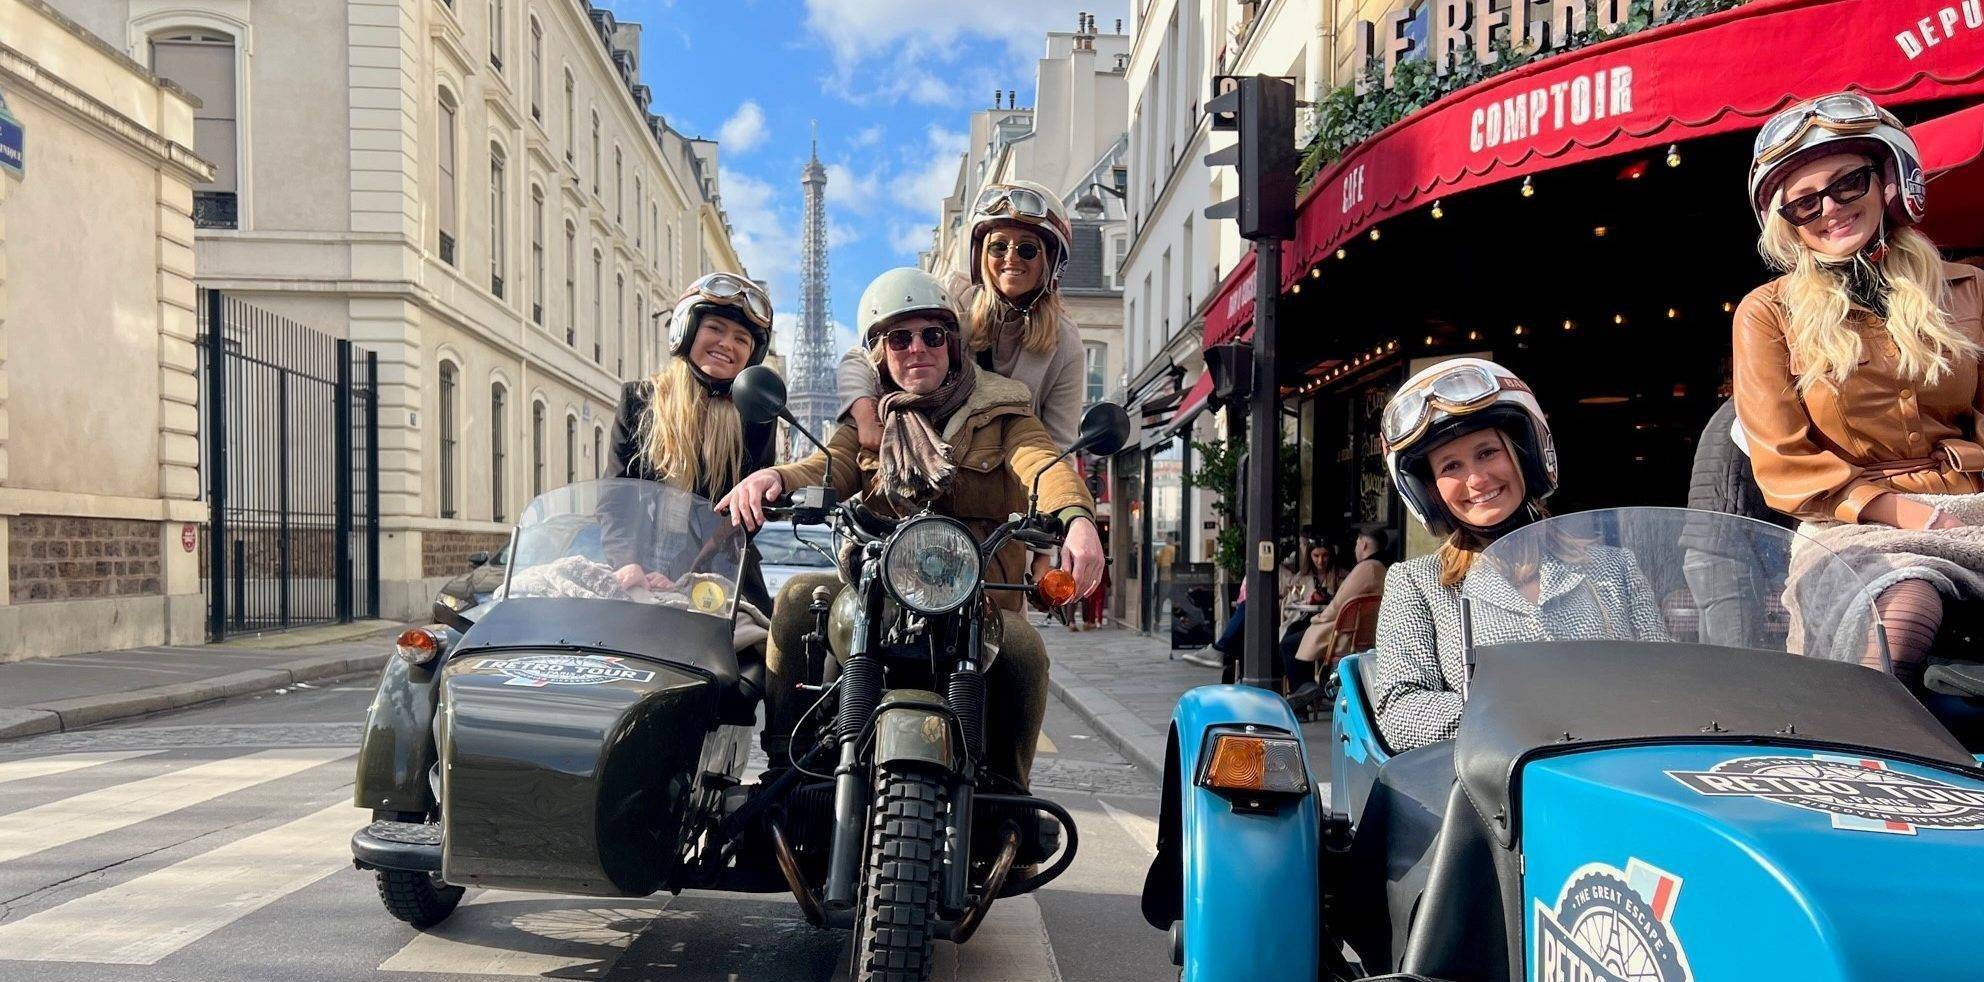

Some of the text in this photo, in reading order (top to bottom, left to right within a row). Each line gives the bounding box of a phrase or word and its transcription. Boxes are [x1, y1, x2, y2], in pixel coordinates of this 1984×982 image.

[1470, 65, 1633, 153] COMPTOIR
[489, 660, 564, 672] RETRO
[575, 666, 638, 679] TOUR
[1695, 775, 1860, 795] RETRO
[1799, 800, 1892, 819] DISCOVER
[1849, 796, 1916, 808] PARIS
[1574, 885, 1664, 952] THE GREAT ESCAPE
[1545, 928, 1608, 982] RET
